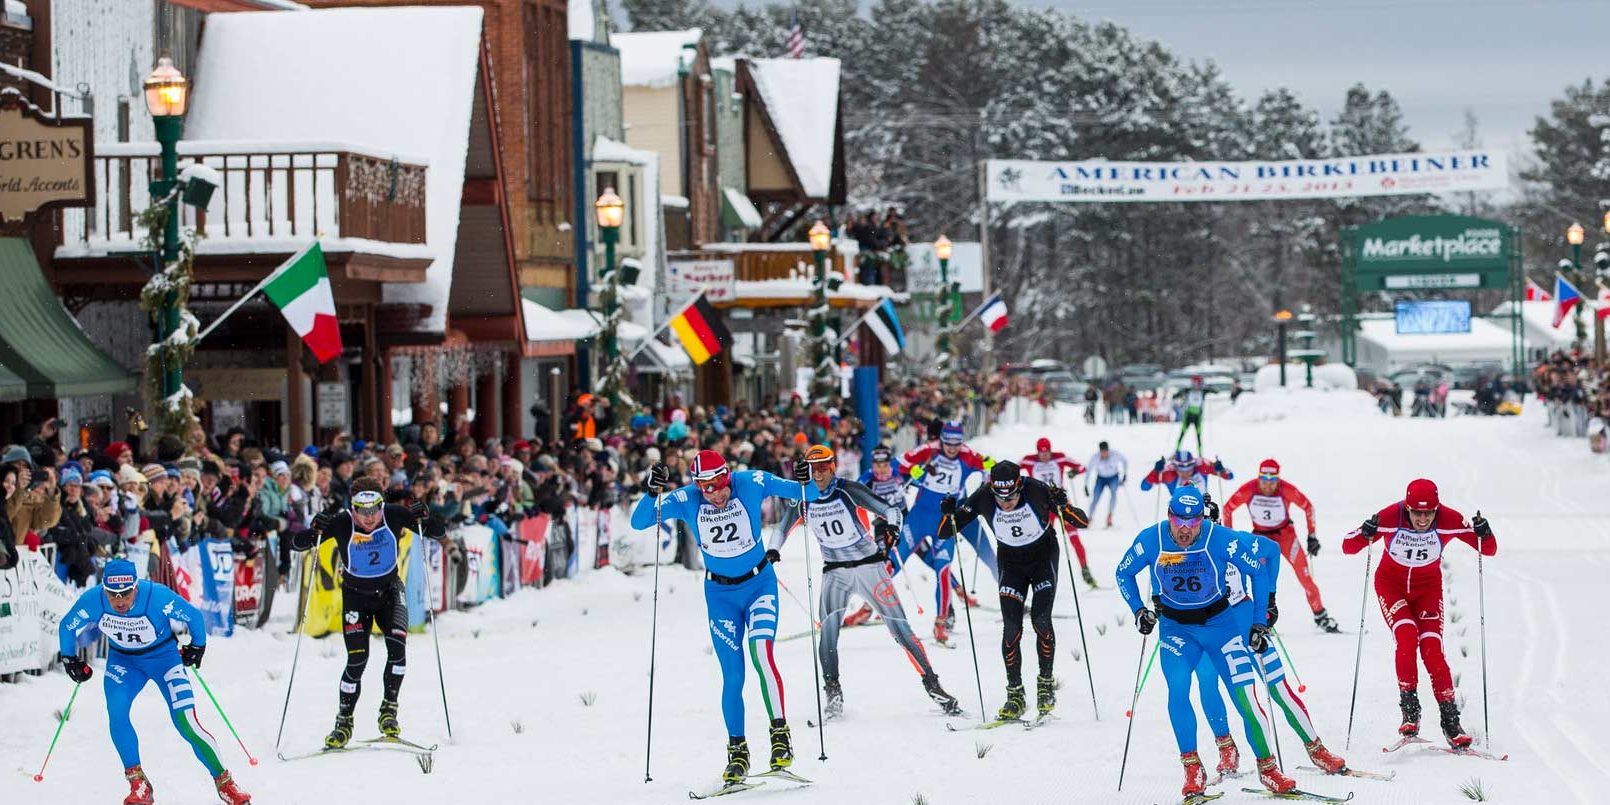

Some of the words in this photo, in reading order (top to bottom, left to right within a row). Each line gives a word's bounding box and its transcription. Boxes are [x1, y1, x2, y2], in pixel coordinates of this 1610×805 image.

[1048, 167, 1240, 181] AMERICAN
[1256, 155, 1490, 178] BIRKEBEINER
[24, 176, 80, 192] Accents
[1363, 234, 1501, 262] Marketplace
[936, 472, 953, 485] 21
[700, 510, 743, 523] Birkebeiner
[1263, 510, 1272, 520] 3
[709, 522, 740, 544] 22
[820, 519, 844, 537] 10
[1010, 525, 1024, 538] 8
[368, 551, 381, 566] 2
[1240, 552, 1261, 570] Audi
[1403, 549, 1429, 561] 15
[1170, 575, 1202, 593] 26
[105, 616, 145, 627] American
[748, 594, 777, 639] ITA
[713, 626, 740, 651] sportful
[1221, 635, 1255, 684] ITA
[163, 663, 195, 710] ITA
